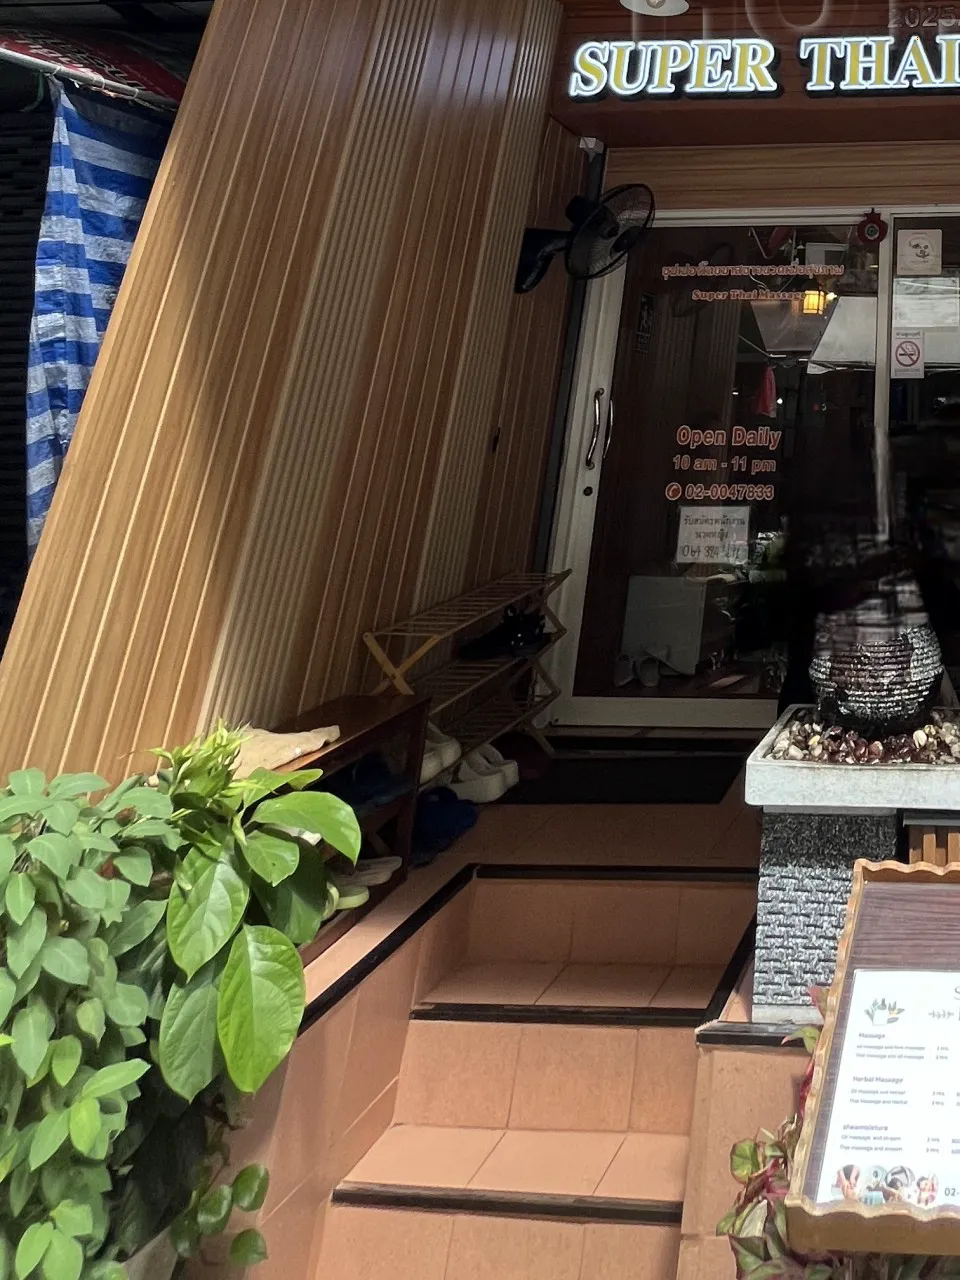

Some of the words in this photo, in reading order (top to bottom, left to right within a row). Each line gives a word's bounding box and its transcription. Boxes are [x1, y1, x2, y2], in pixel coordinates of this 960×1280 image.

[569, 39, 778, 98] SUPER
[692, 289, 728, 302] Super
[729, 289, 757, 300] Thai
[676, 425, 726, 448] Open
[732, 426, 782, 450] Daily
[673, 455, 691, 470] 10
[693, 458, 718, 471] am
[731, 455, 748, 471] 11
[751, 459, 777, 475] pm
[685, 483, 775, 500] 02-0047833
